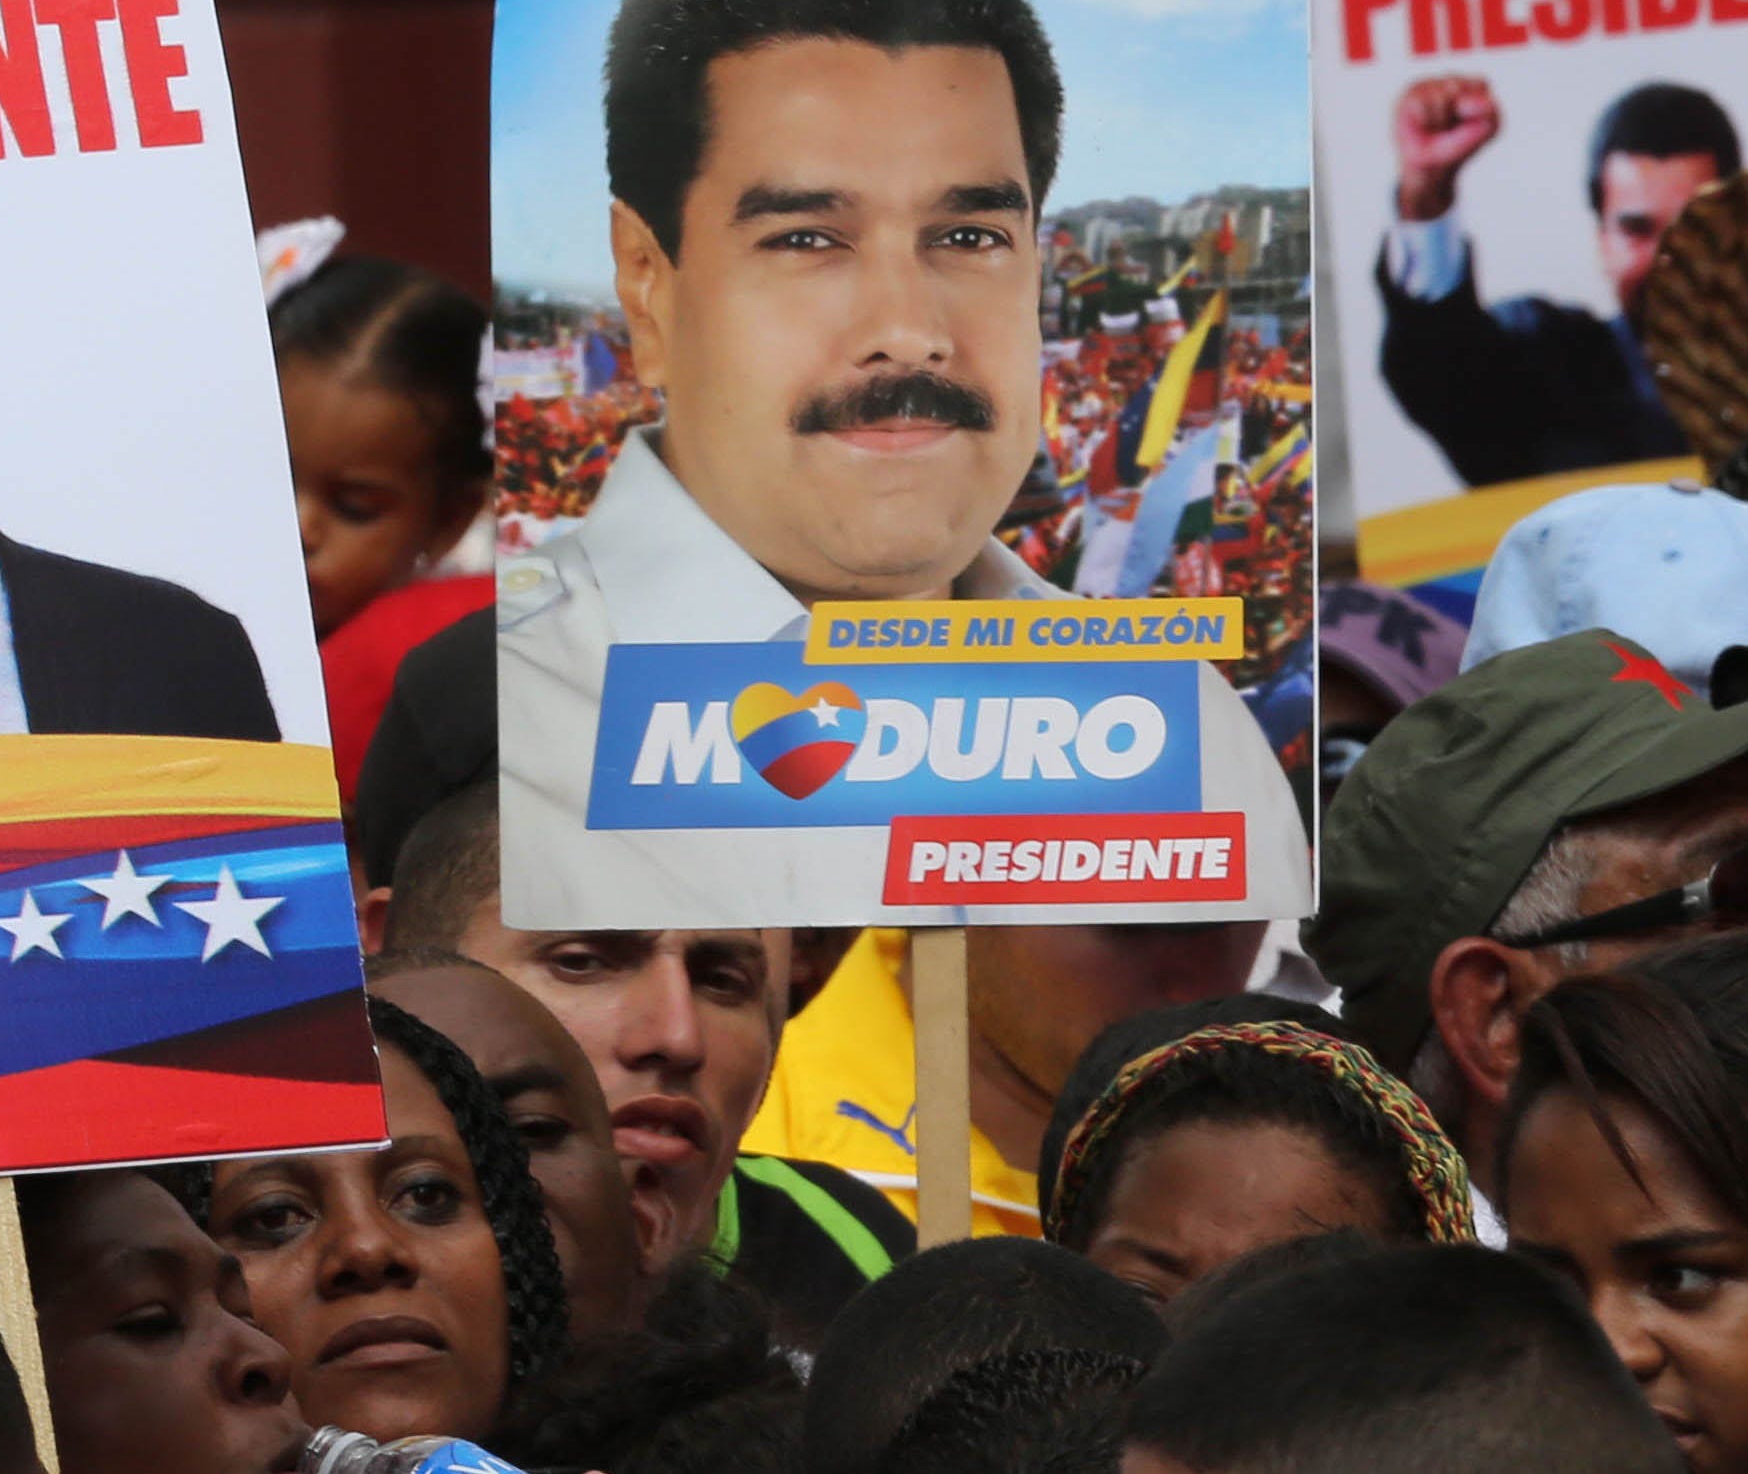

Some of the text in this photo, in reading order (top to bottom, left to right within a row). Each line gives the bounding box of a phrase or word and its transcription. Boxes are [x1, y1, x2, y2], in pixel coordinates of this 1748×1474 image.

[829, 609, 1225, 648] DESDE MI CORAZÓN
[909, 838, 1232, 883] PRESIDENTE
